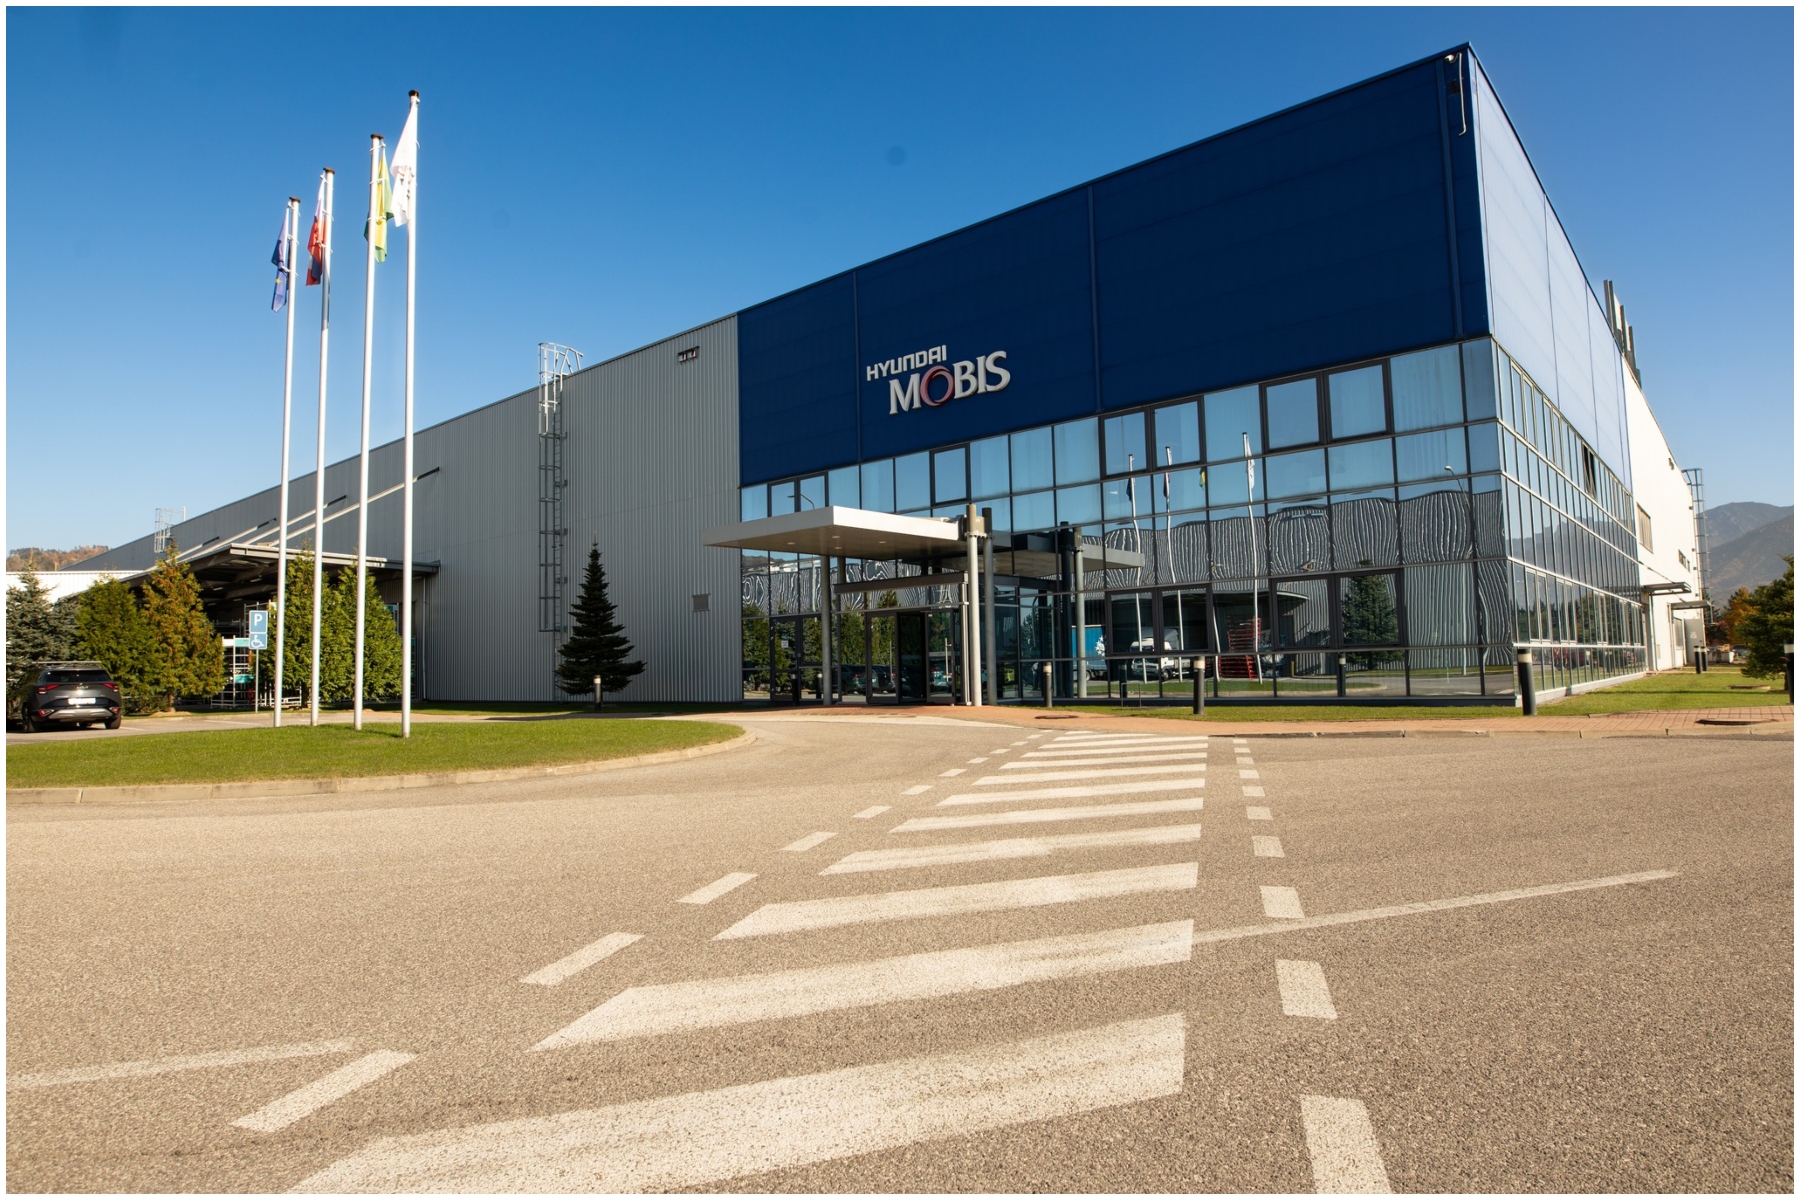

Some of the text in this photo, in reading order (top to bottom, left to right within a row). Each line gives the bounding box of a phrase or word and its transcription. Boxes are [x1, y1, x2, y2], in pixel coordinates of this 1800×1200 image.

[866, 344, 947, 381] HYUNDAI
[888, 350, 1011, 415] MOBIS
[254, 613, 263, 626] P
